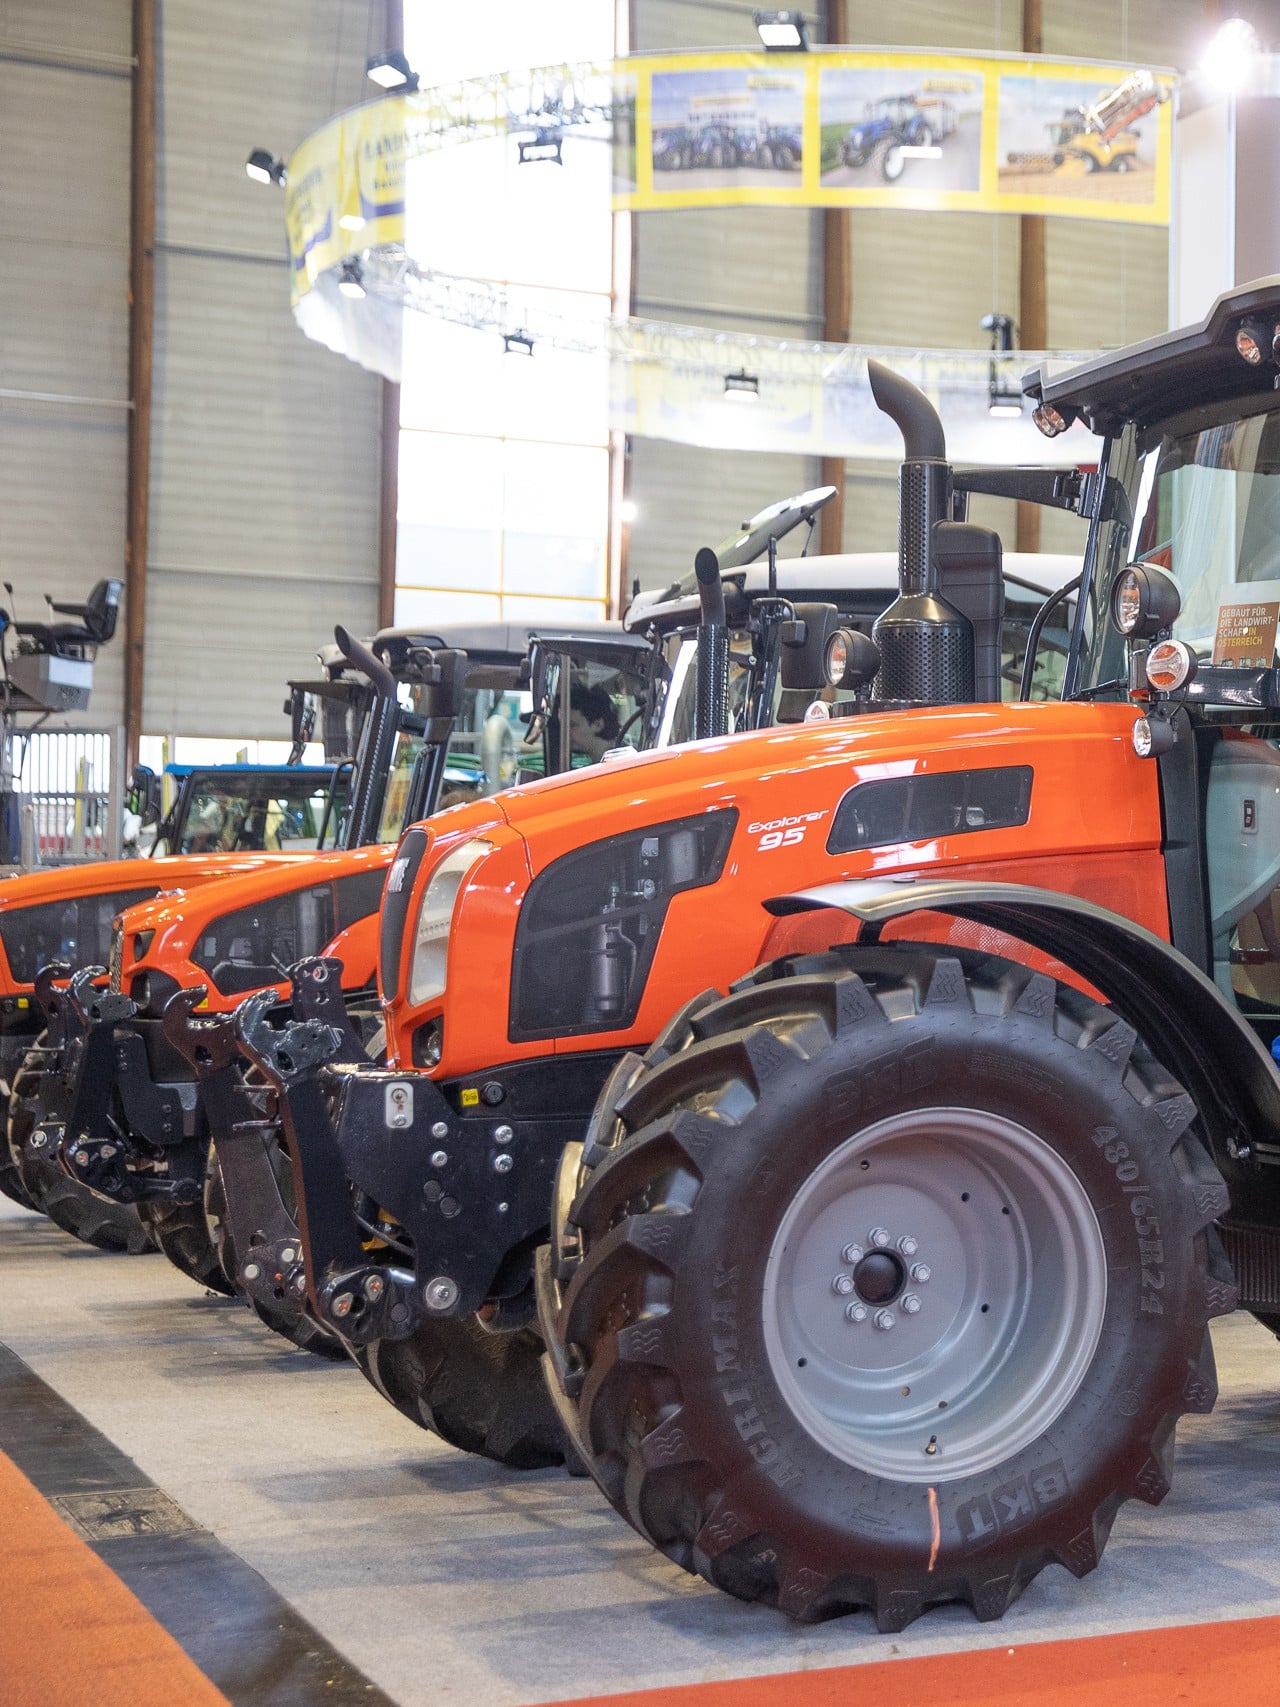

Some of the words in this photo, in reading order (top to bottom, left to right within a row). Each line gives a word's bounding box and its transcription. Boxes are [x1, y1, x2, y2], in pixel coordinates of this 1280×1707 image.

[1221, 608, 1250, 618] GEBAUT
[1251, 606, 1266, 616] FÜR
[1220, 618, 1233, 627] DIE
[1233, 616, 1275, 627] LANDWIRT-
[1219, 627, 1248, 637] SCHAF
[1248, 627, 1257, 636] IN
[747, 809, 830, 834] Explorer
[757, 825, 807, 852] 95
[965, 1470, 1070, 1542] BKT
